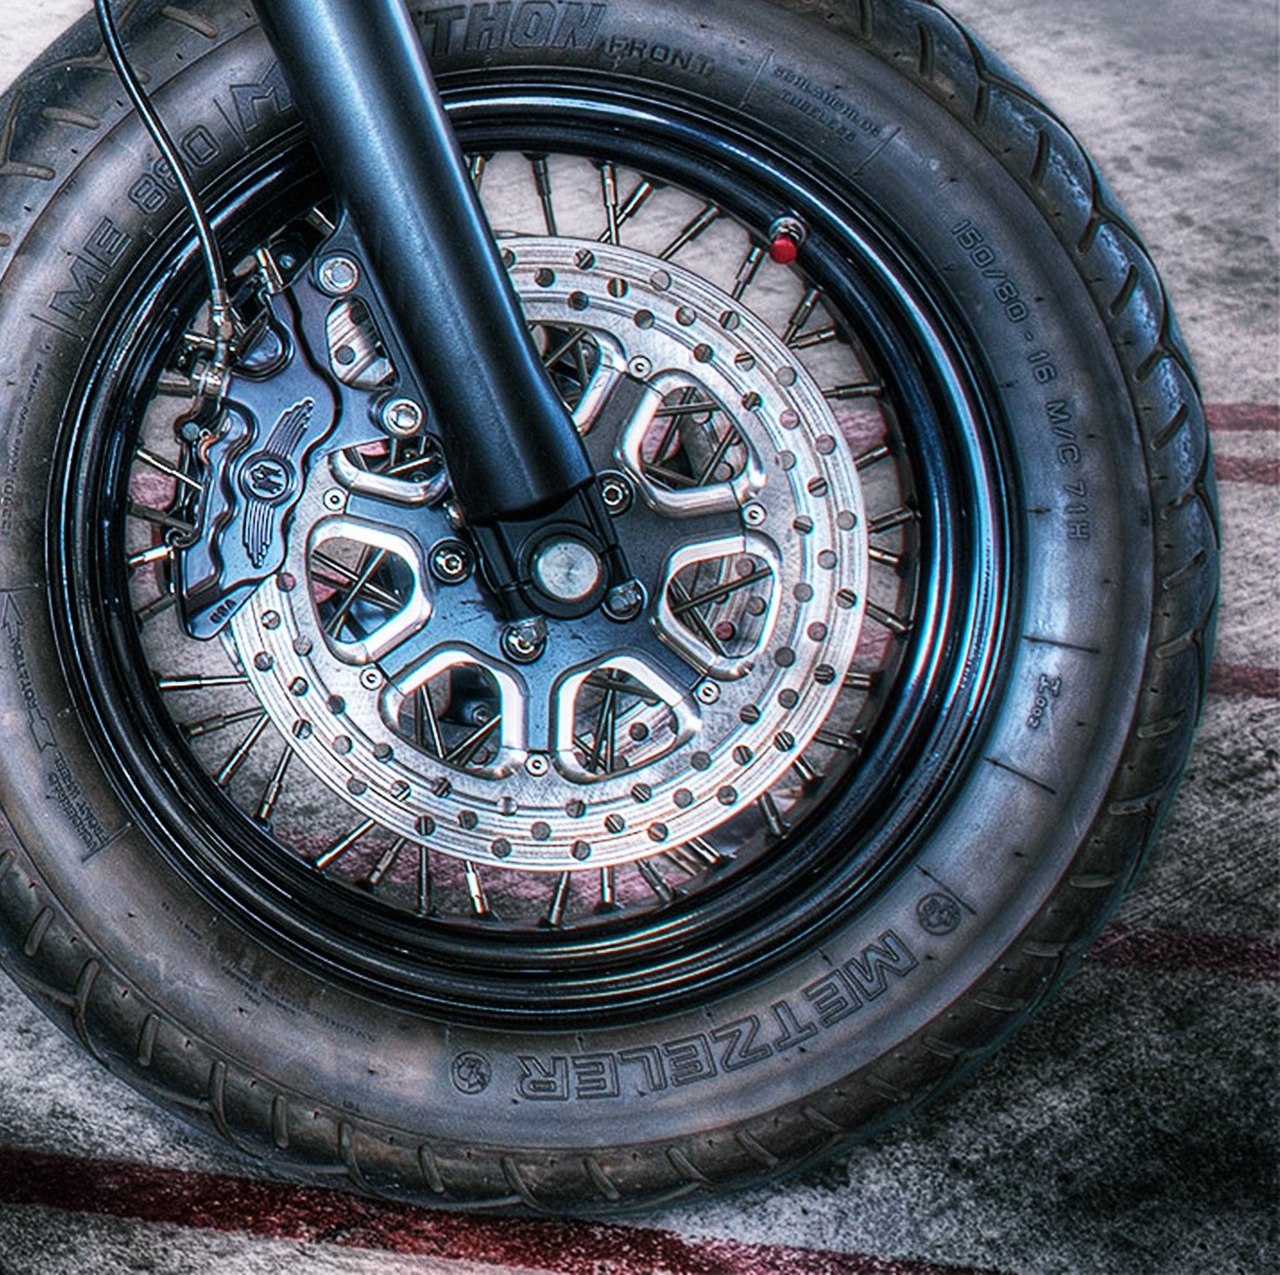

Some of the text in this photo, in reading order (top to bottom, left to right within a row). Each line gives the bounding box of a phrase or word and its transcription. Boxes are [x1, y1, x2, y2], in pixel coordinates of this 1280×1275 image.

[606, 35, 717, 76] FRONT
[48, 216, 132, 322] ME
[1046, 399, 1081, 466] M/C
[1063, 480, 1090, 541] 71H
[516, 929, 920, 1101] METZELER
